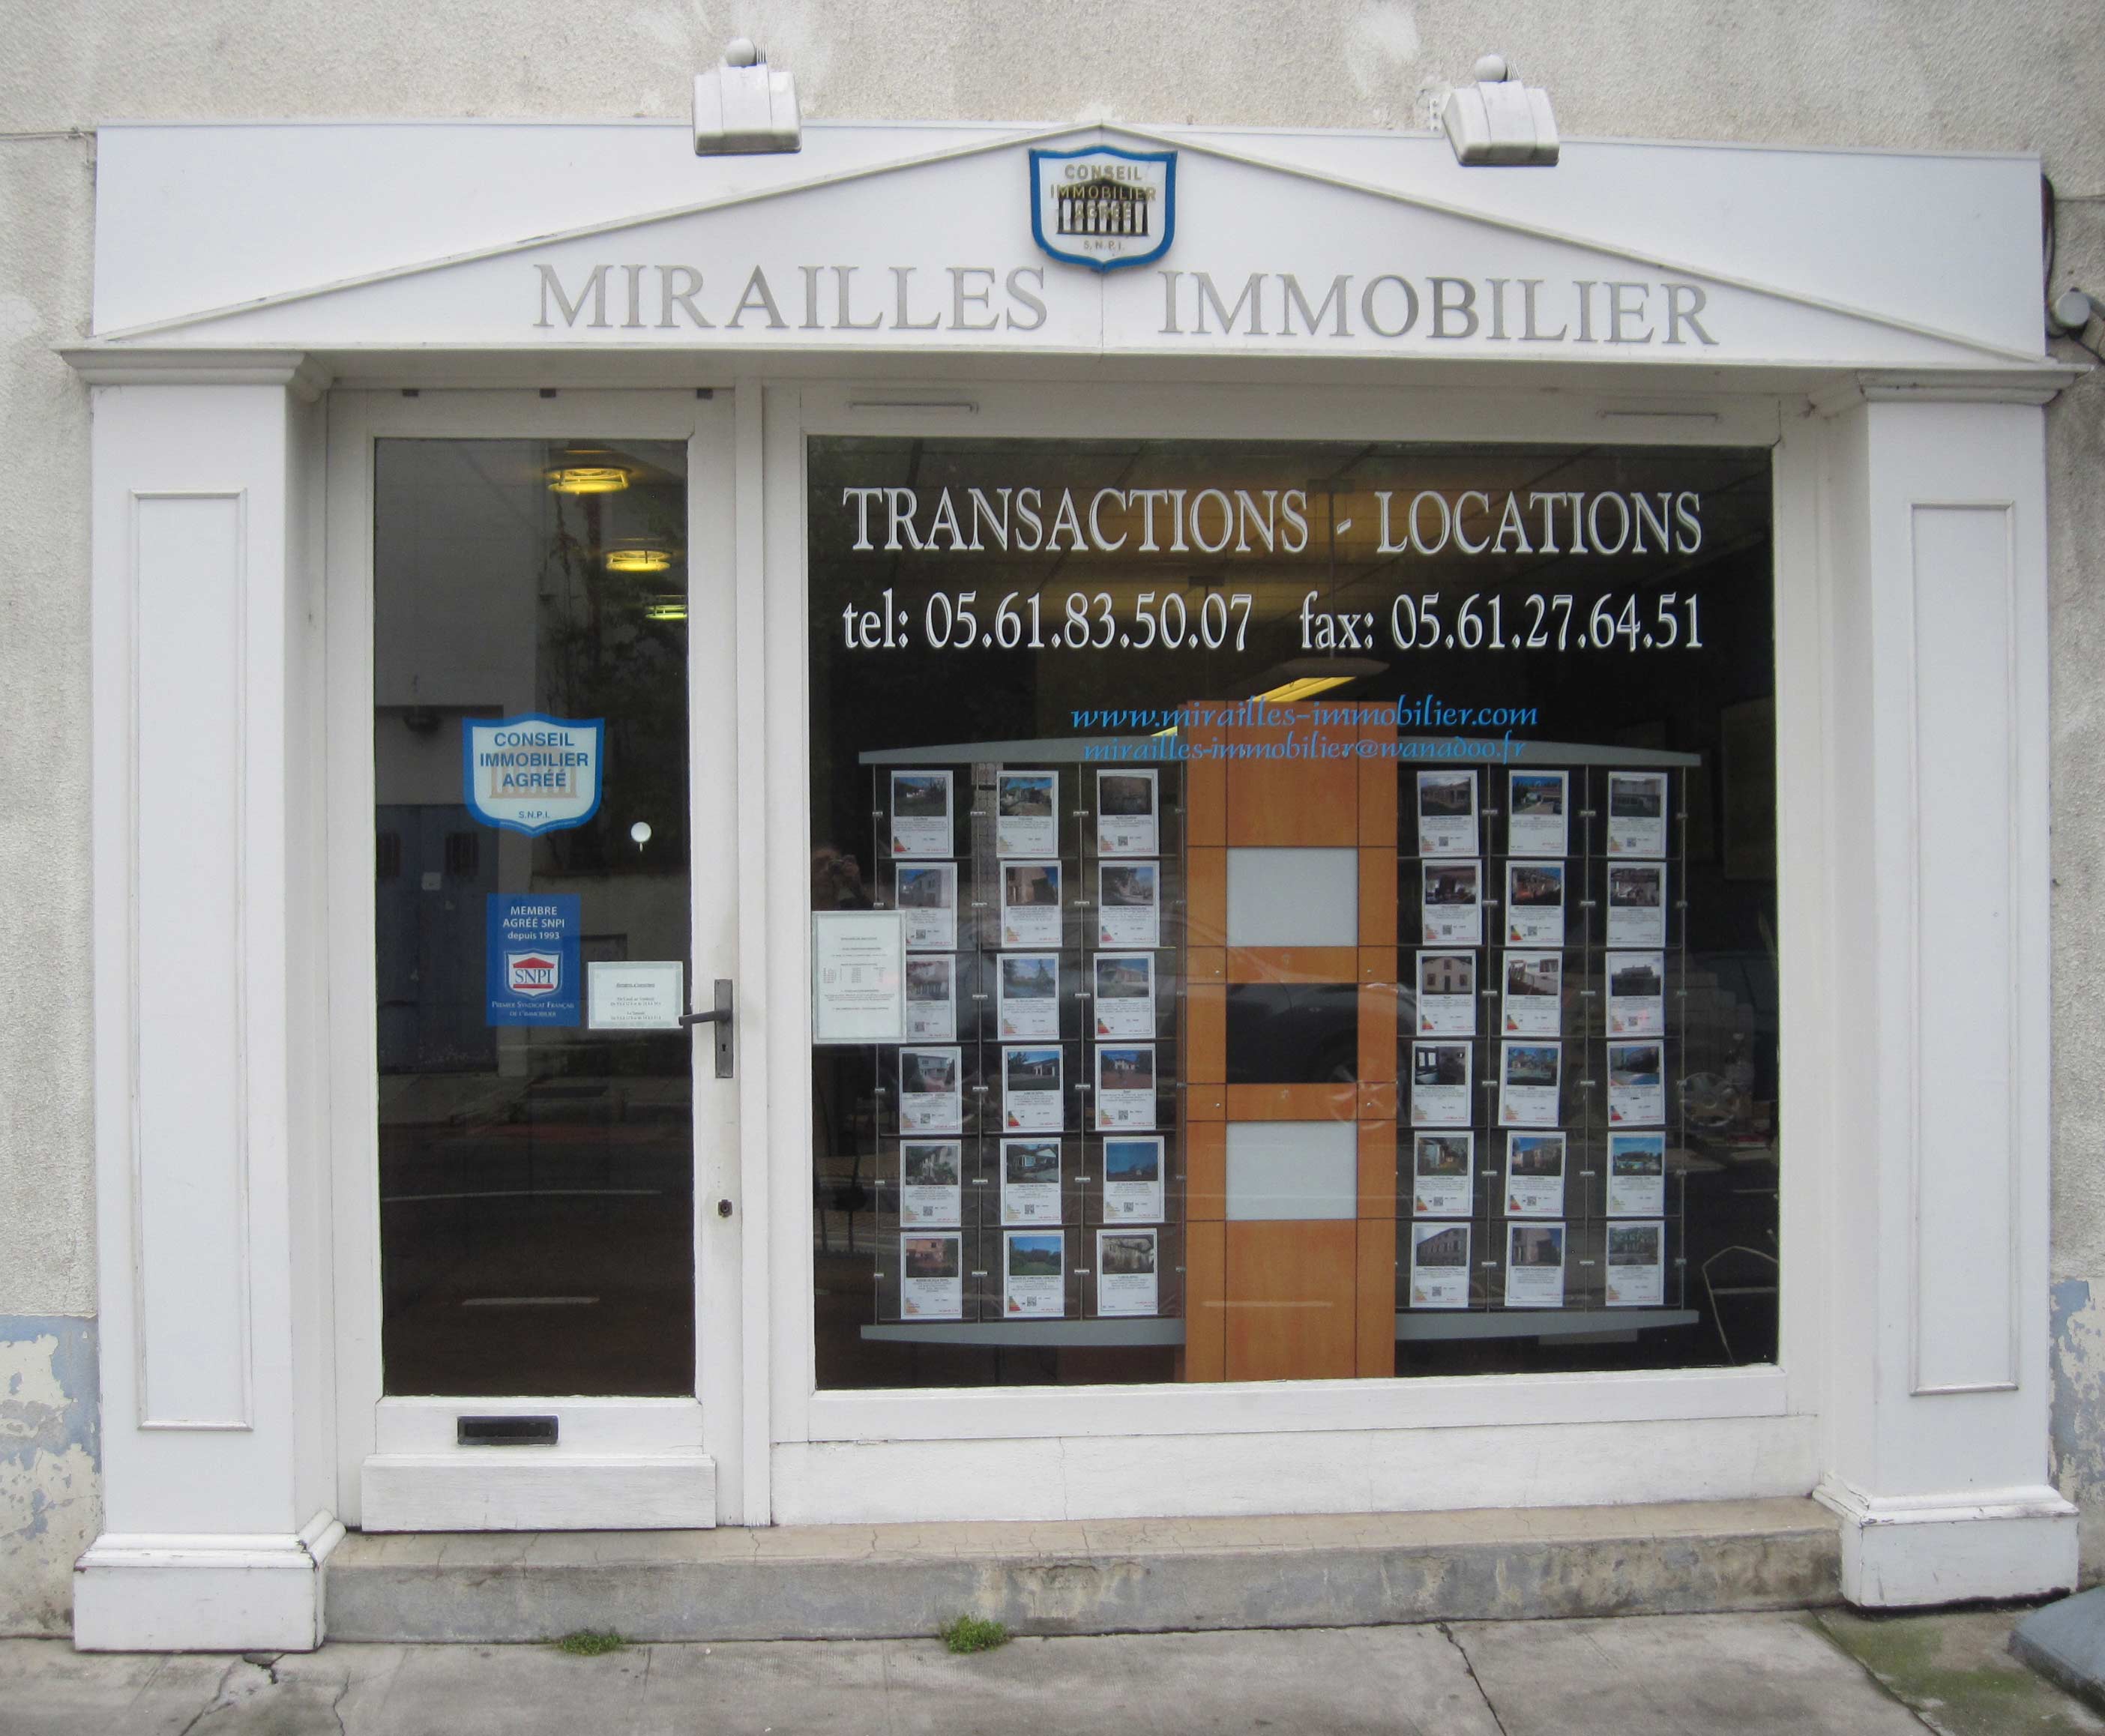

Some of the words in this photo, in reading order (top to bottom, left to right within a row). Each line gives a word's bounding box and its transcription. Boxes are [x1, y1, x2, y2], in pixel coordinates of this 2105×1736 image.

[1064, 164, 1142, 181] CONSEIL
[1050, 184, 1157, 201] IMMOBILIER
[533, 265, 1048, 331] MIRAILLES
[1157, 270, 1720, 346] IMMOBILIER
[843, 486, 1309, 554] TRANSACTIONS
[1374, 490, 1703, 555] LOCATIONS
[842, 588, 909, 649] tel:
[925, 590, 1253, 652] 05.61.83.50.07
[1299, 590, 1375, 650] fax:
[1391, 591, 1703, 652] 05.61.27.64.51
[1070, 694, 1538, 728] www.mirailles-immobilier.com
[493, 732, 575, 747] CONSEIL
[1082, 730, 1528, 765] mirailles-immobilier@wanadoo.fr
[480, 752, 589, 767] IMMOBILIER
[502, 768, 567, 787] AGRÉÉ
[510, 905, 558, 915] MEMBRE
[502, 917, 538, 928] AGRÉÉ
[540, 918, 565, 929] SNPI
[507, 931, 537, 941] depuis
[539, 932, 560, 940] 1993
[514, 968, 552, 984] SNPI
